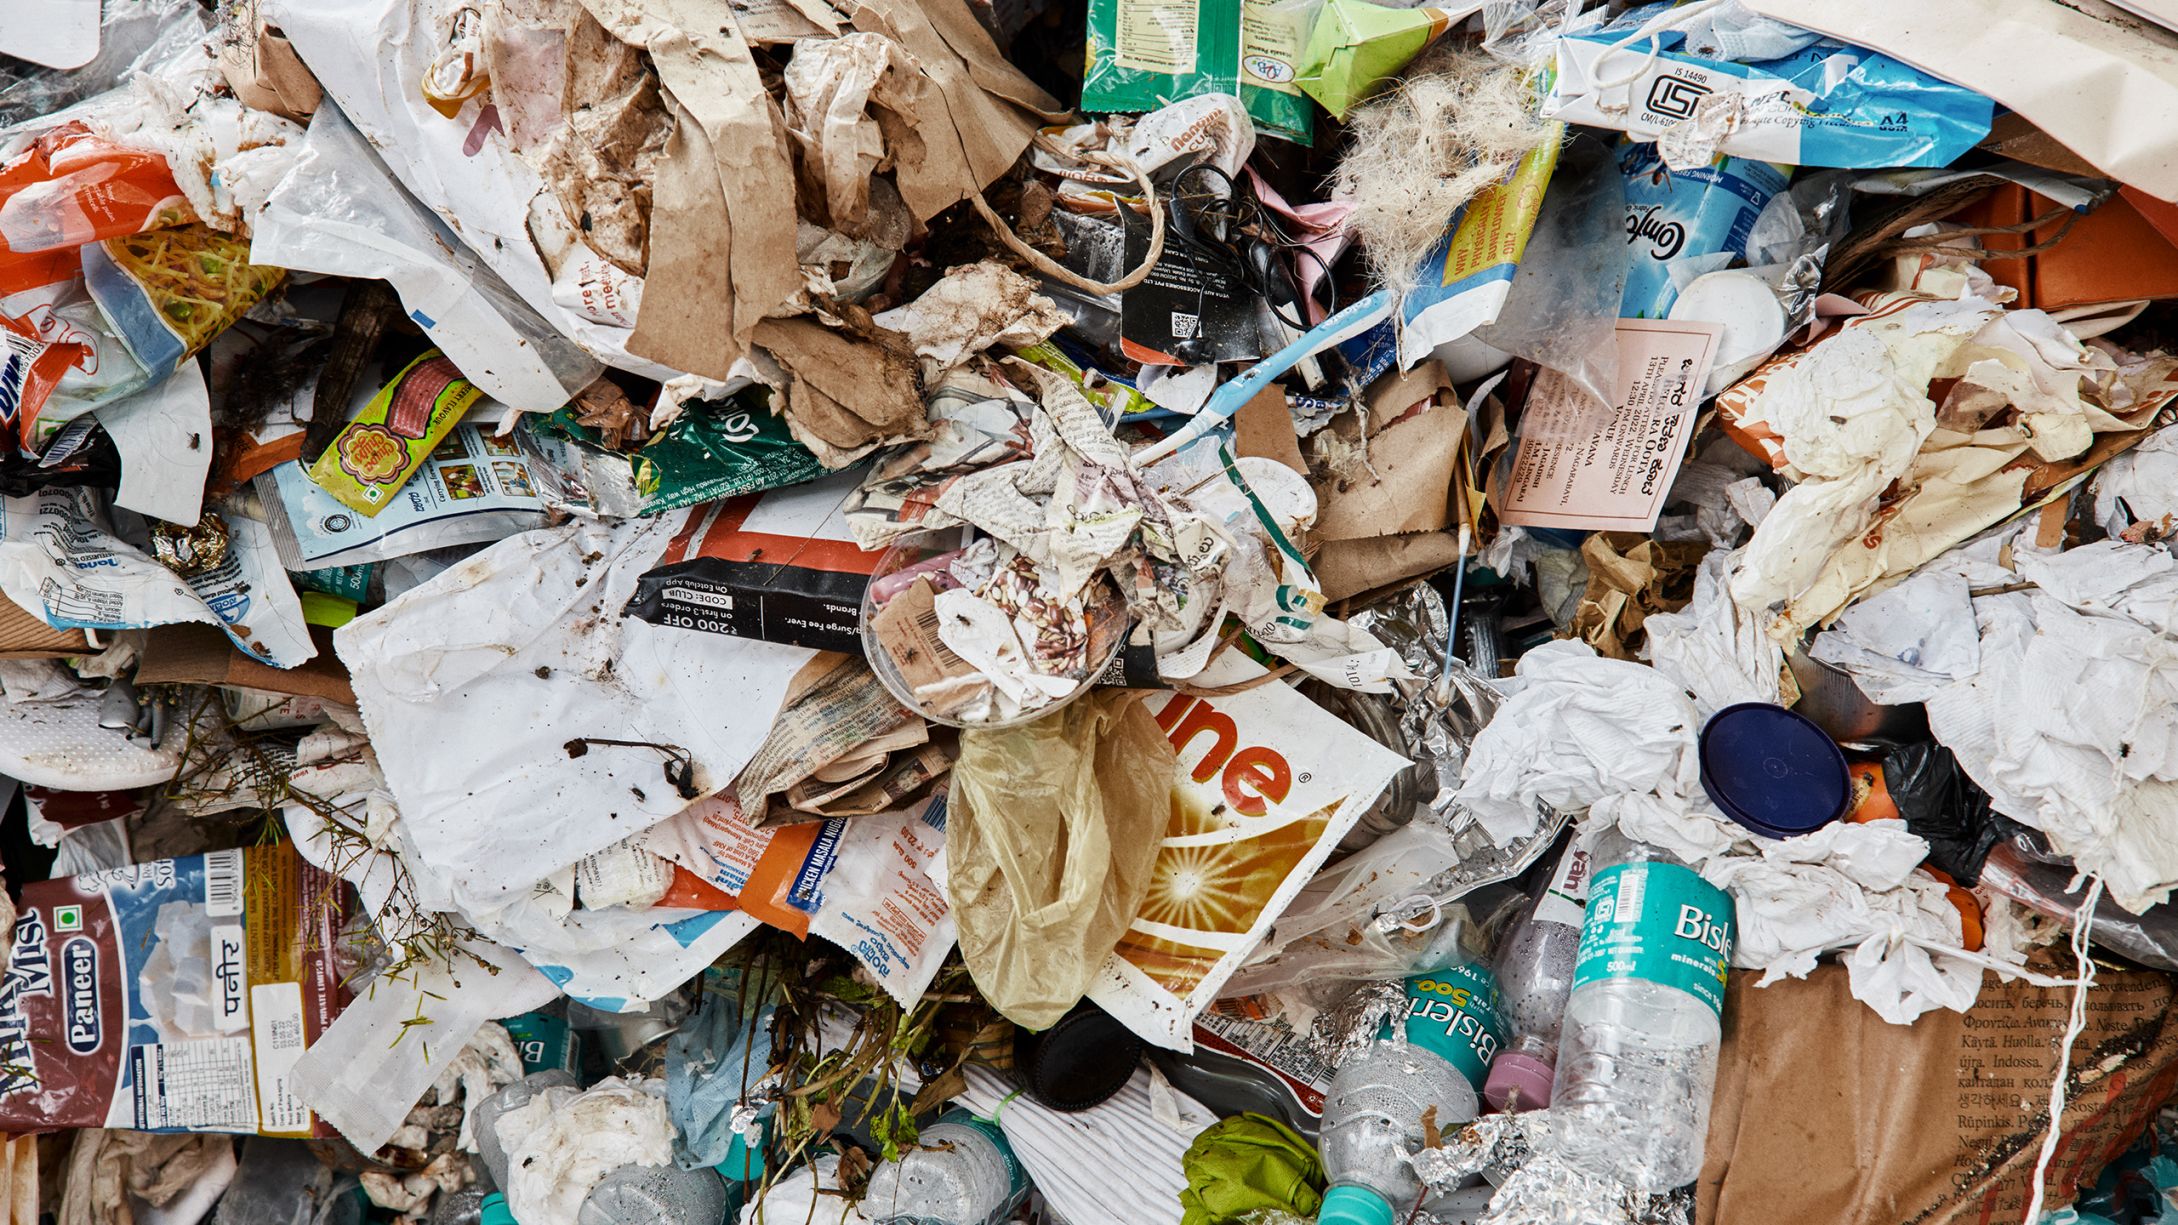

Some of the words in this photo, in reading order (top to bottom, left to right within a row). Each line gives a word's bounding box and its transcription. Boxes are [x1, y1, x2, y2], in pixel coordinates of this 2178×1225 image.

[1684, 68, 1707, 83] 14490
[1471, 207, 1490, 268] PHYSICALLY
[1487, 193, 1507, 261] SUNFLOWER
[1163, 248, 1178, 256] CARE
[1503, 232, 1516, 255] OIL?
[1454, 249, 1468, 275] WHY
[1644, 355, 1658, 380] 13TH
[1626, 379, 1640, 407] 12:30
[1635, 381, 1649, 407] APRIL
[430, 400, 461, 427] FLAVOUR
[1621, 407, 1632, 423] PM
[1634, 405, 1651, 443] ATTEND
[352, 430, 385, 466] Chups
[362, 439, 395, 476] Chupa
[1607, 423, 1627, 470] ONWARDS
[1628, 444, 1640, 464] FOR
[1635, 438, 1656, 477] OOTA
[1531, 446, 1550, 489] JAGADISH
[1608, 436, 1632, 495] WEDNESDAY
[680, 483, 696, 495] High
[1515, 460, 1536, 503] LINGARAJ
[1617, 463, 1634, 496] LUNCH
[432, 480, 447, 503] Carrying
[664, 488, 681, 500] way,
[666, 579, 684, 588] App
[669, 590, 693, 600] CLUB
[686, 582, 714, 593] Eatclub
[715, 586, 728, 594] On
[695, 593, 727, 605] CODE:
[823, 603, 857, 616] Brands.
[663, 613, 694, 628] OFF
[693, 608, 699, 616] 3
[700, 608, 718, 619] first
[785, 617, 807, 628] Ever.
[712, 839, 726, 850] KMF
[731, 847, 744, 858] Unit
[815, 833, 833, 869] MASALA
[902, 853, 918, 869] 500
[315, 959, 325, 990] LIMITED
[1606, 960, 1636, 972] 500ml
[1671, 953, 1716, 977] minerals
[215, 938, 240, 1016] पनीर
[69, 944, 96, 1043] Paneer
[1693, 982, 1712, 999] since
[317, 991, 328, 1025] PRIVATE
[2022, 996, 2067, 1010] беречь,
[2003, 1034, 2045, 1048] Huolla.
[1993, 1056, 2043, 1068] Indossa.
[135, 1058, 143, 1095] INFORMATION
[275, 1078, 283, 1106] Packaging
